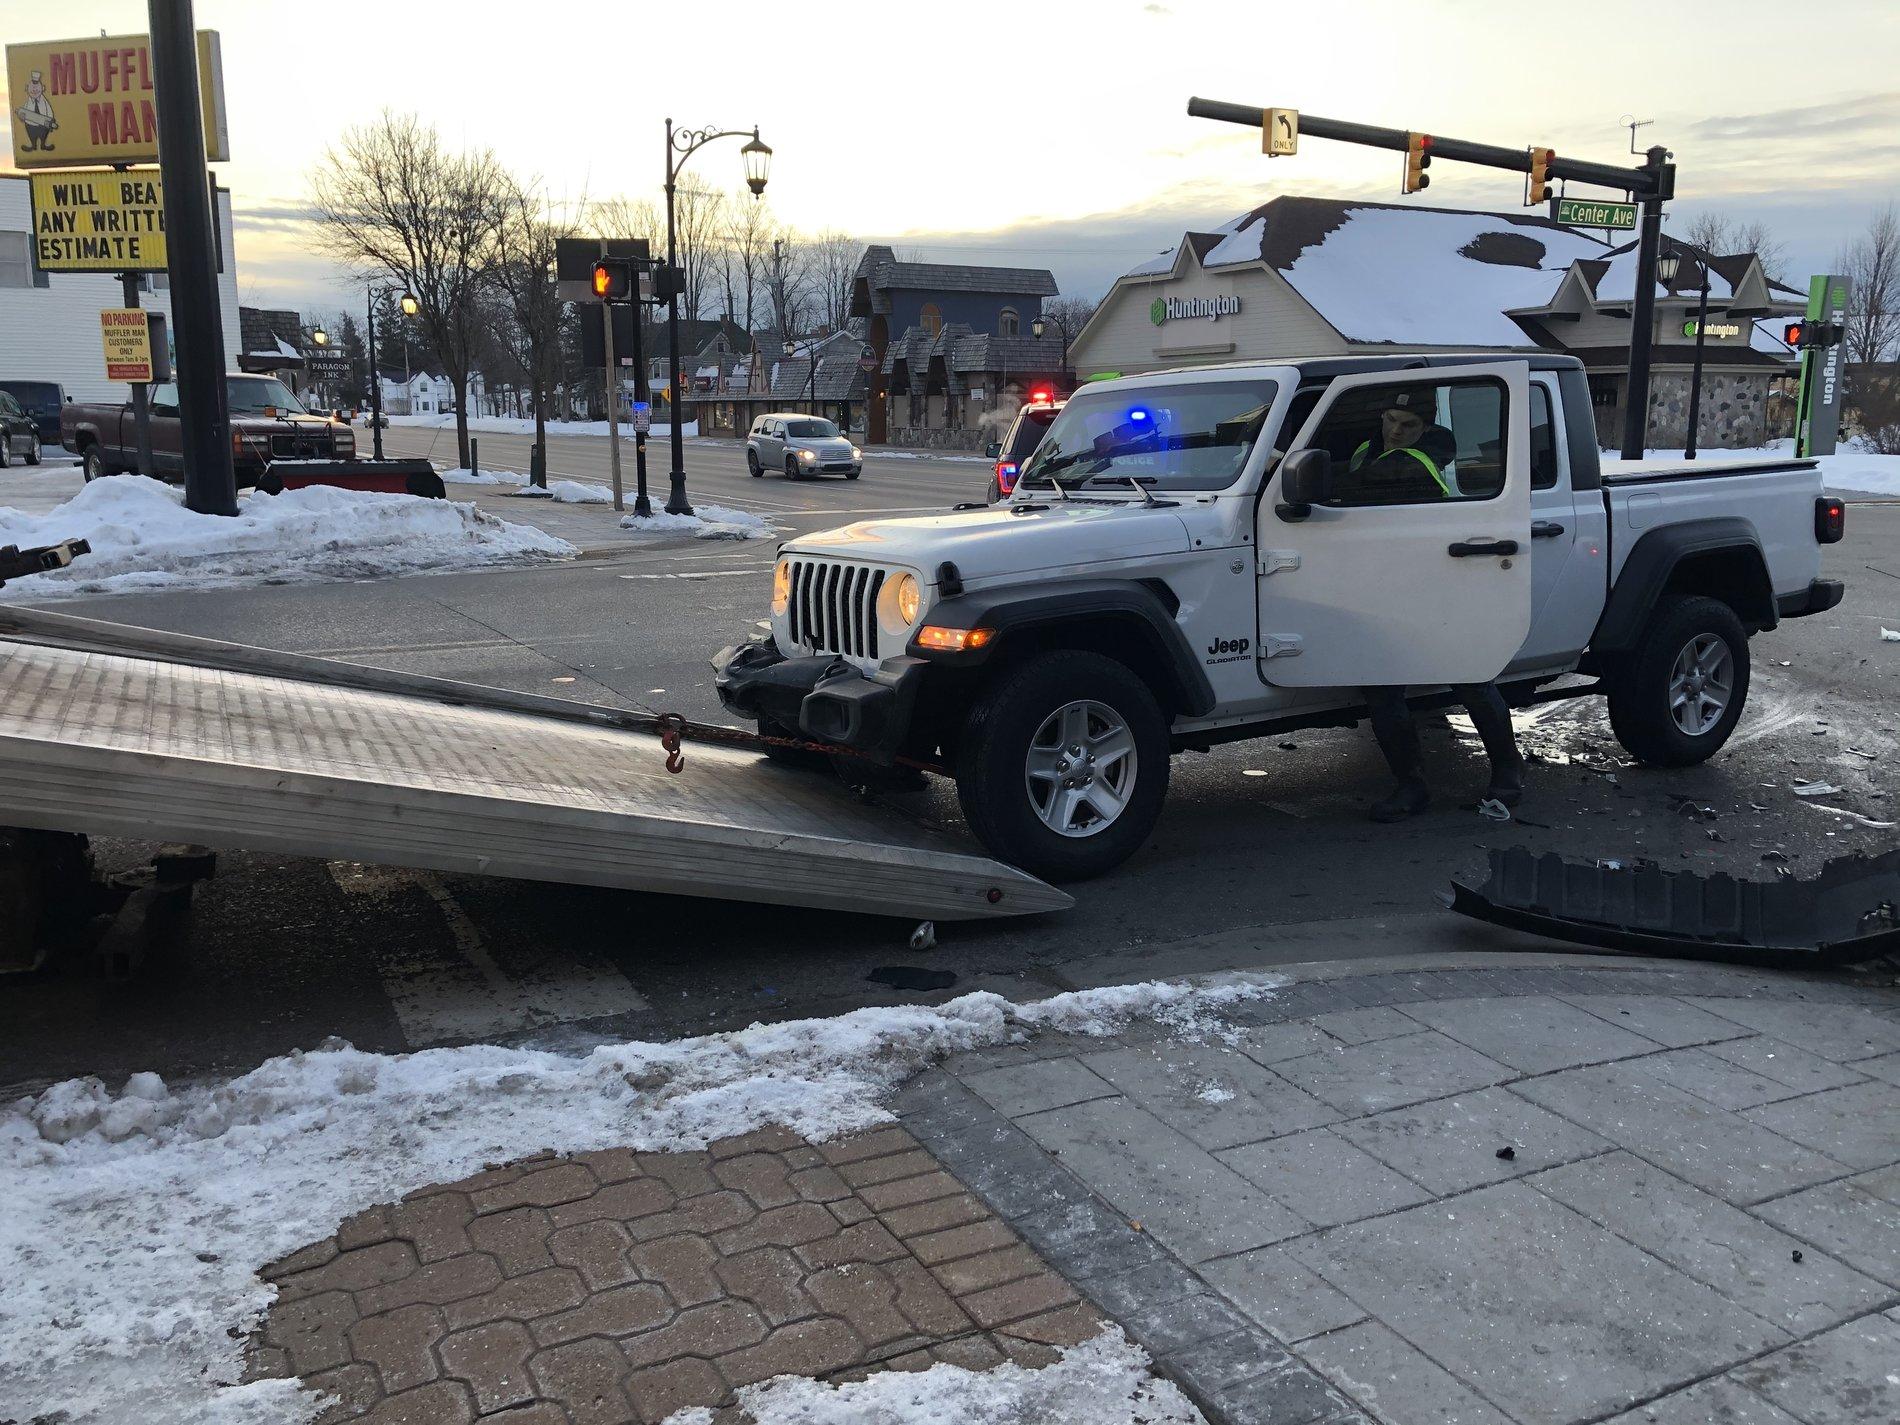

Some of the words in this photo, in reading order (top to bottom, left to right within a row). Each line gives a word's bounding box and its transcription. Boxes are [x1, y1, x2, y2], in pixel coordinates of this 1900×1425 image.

[49, 47, 153, 96] MUFFL
[88, 100, 157, 145] MAN
[1274, 140, 1294, 150] ONLY
[53, 184, 99, 206] WILL
[121, 182, 162, 205] BEA
[41, 211, 76, 233] ANY
[91, 210, 165, 232] WRITTE
[1571, 204, 1609, 223] Center
[1612, 207, 1633, 225] Ave
[40, 237, 140, 260] ESTIMATE
[1166, 295, 1241, 321] Huntington
[101, 313, 112, 326] NO
[113, 312, 146, 326] PARKING
[105, 329, 130, 337] MUFFLER
[131, 329, 146, 337] MAN
[109, 338, 143, 347] CUSTOMERS
[119, 347, 133, 355] ONLY
[323, 371, 339, 379] INK
[1207, 637, 1250, 655] Jeep
[1206, 655, 1252, 665] GLADIATOR
